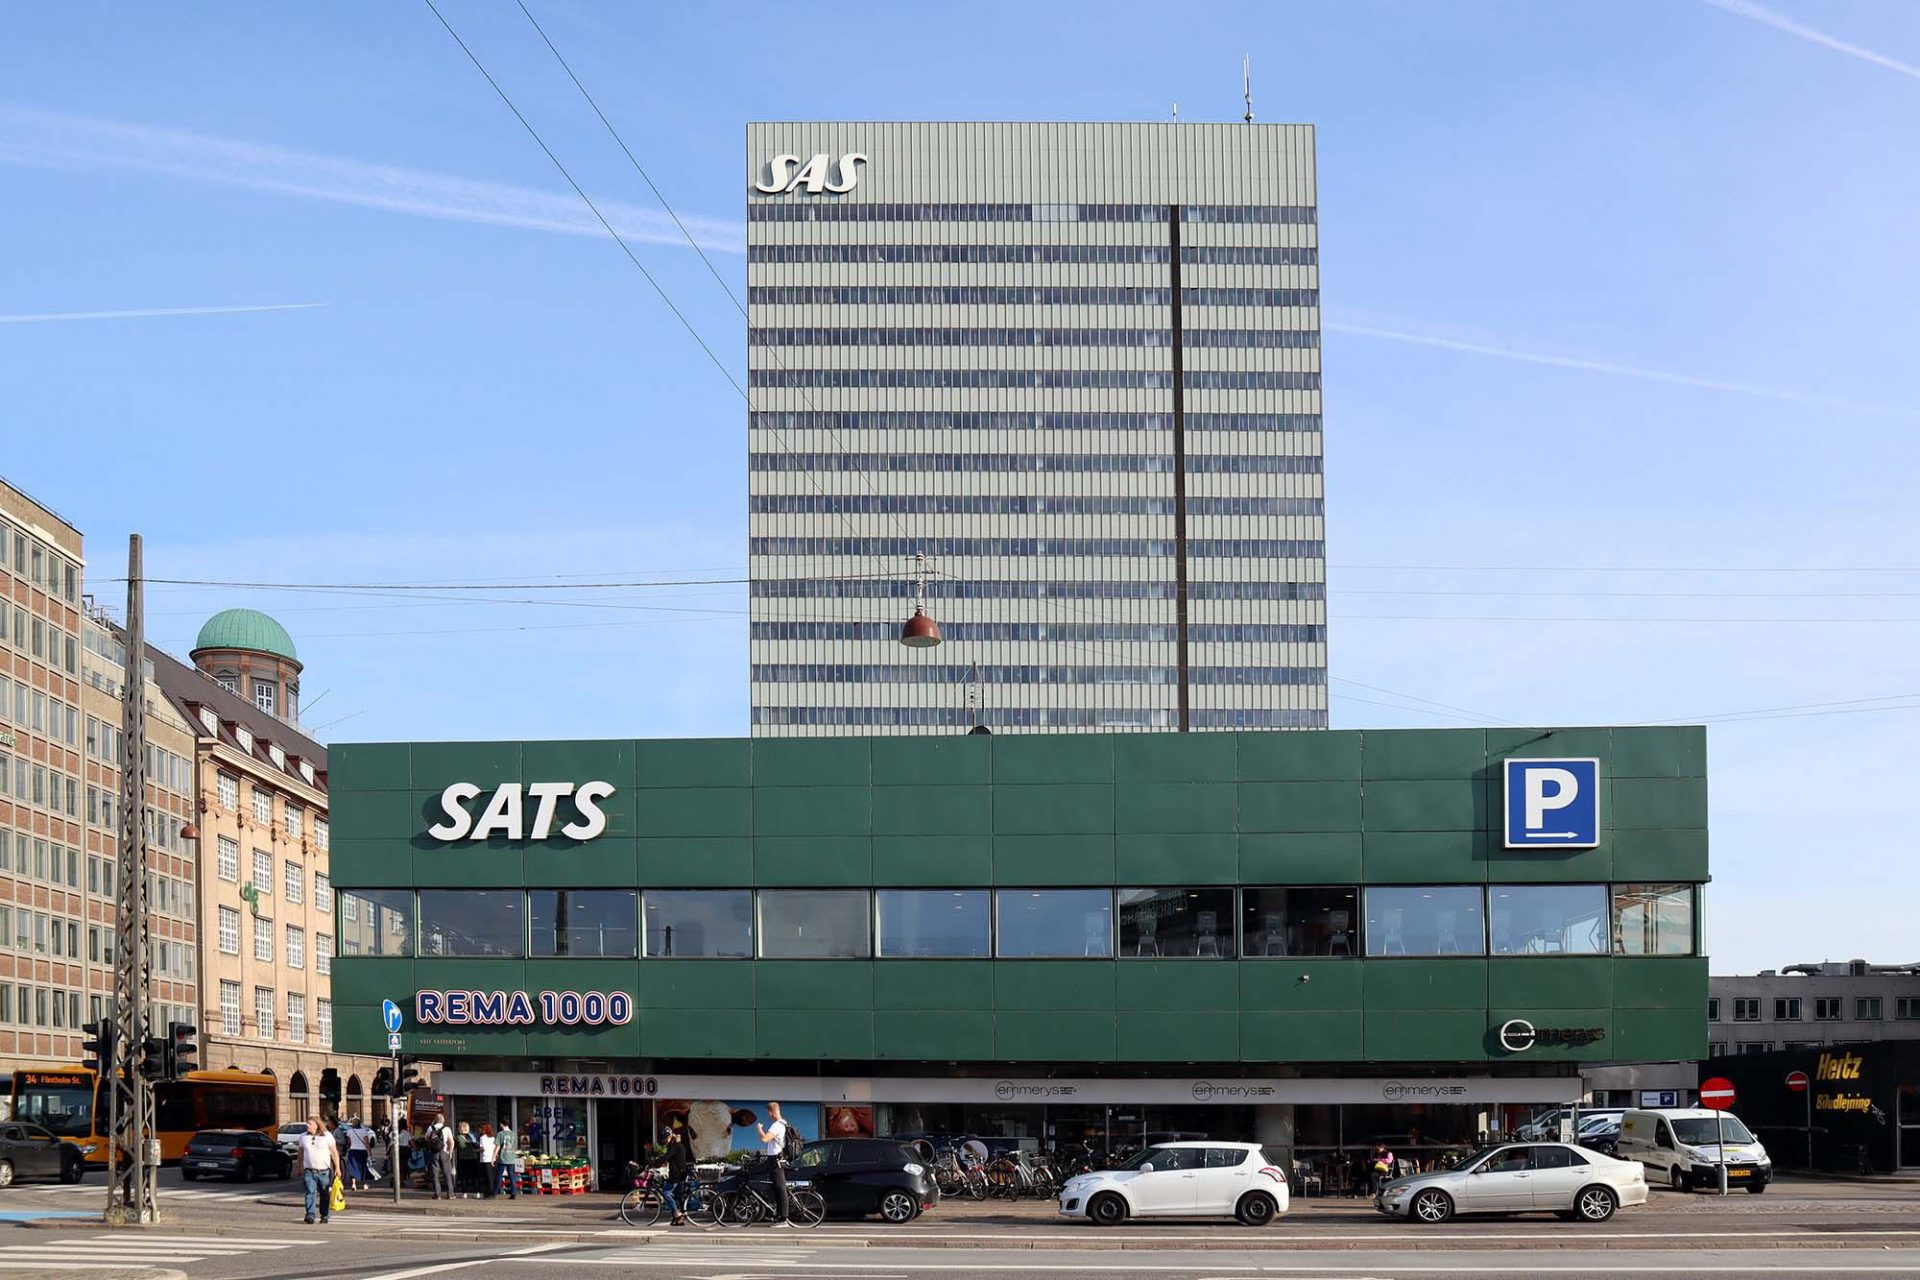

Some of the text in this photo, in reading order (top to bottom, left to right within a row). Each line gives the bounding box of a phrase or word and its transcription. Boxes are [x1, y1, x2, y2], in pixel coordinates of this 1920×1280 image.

[756, 153, 868, 192] SAS
[1525, 768, 1578, 829] P
[428, 781, 616, 841] SATS
[416, 990, 633, 1025] REMA 1000
[1816, 1052, 1862, 1080] Hertz
[25, 1074, 37, 1084] 34
[540, 1075, 659, 1096] REMA 1000
[996, 1083, 1060, 1098] emmerys
[1193, 1083, 1258, 1098] emmerys
[1384, 1083, 1449, 1098] emmerys
